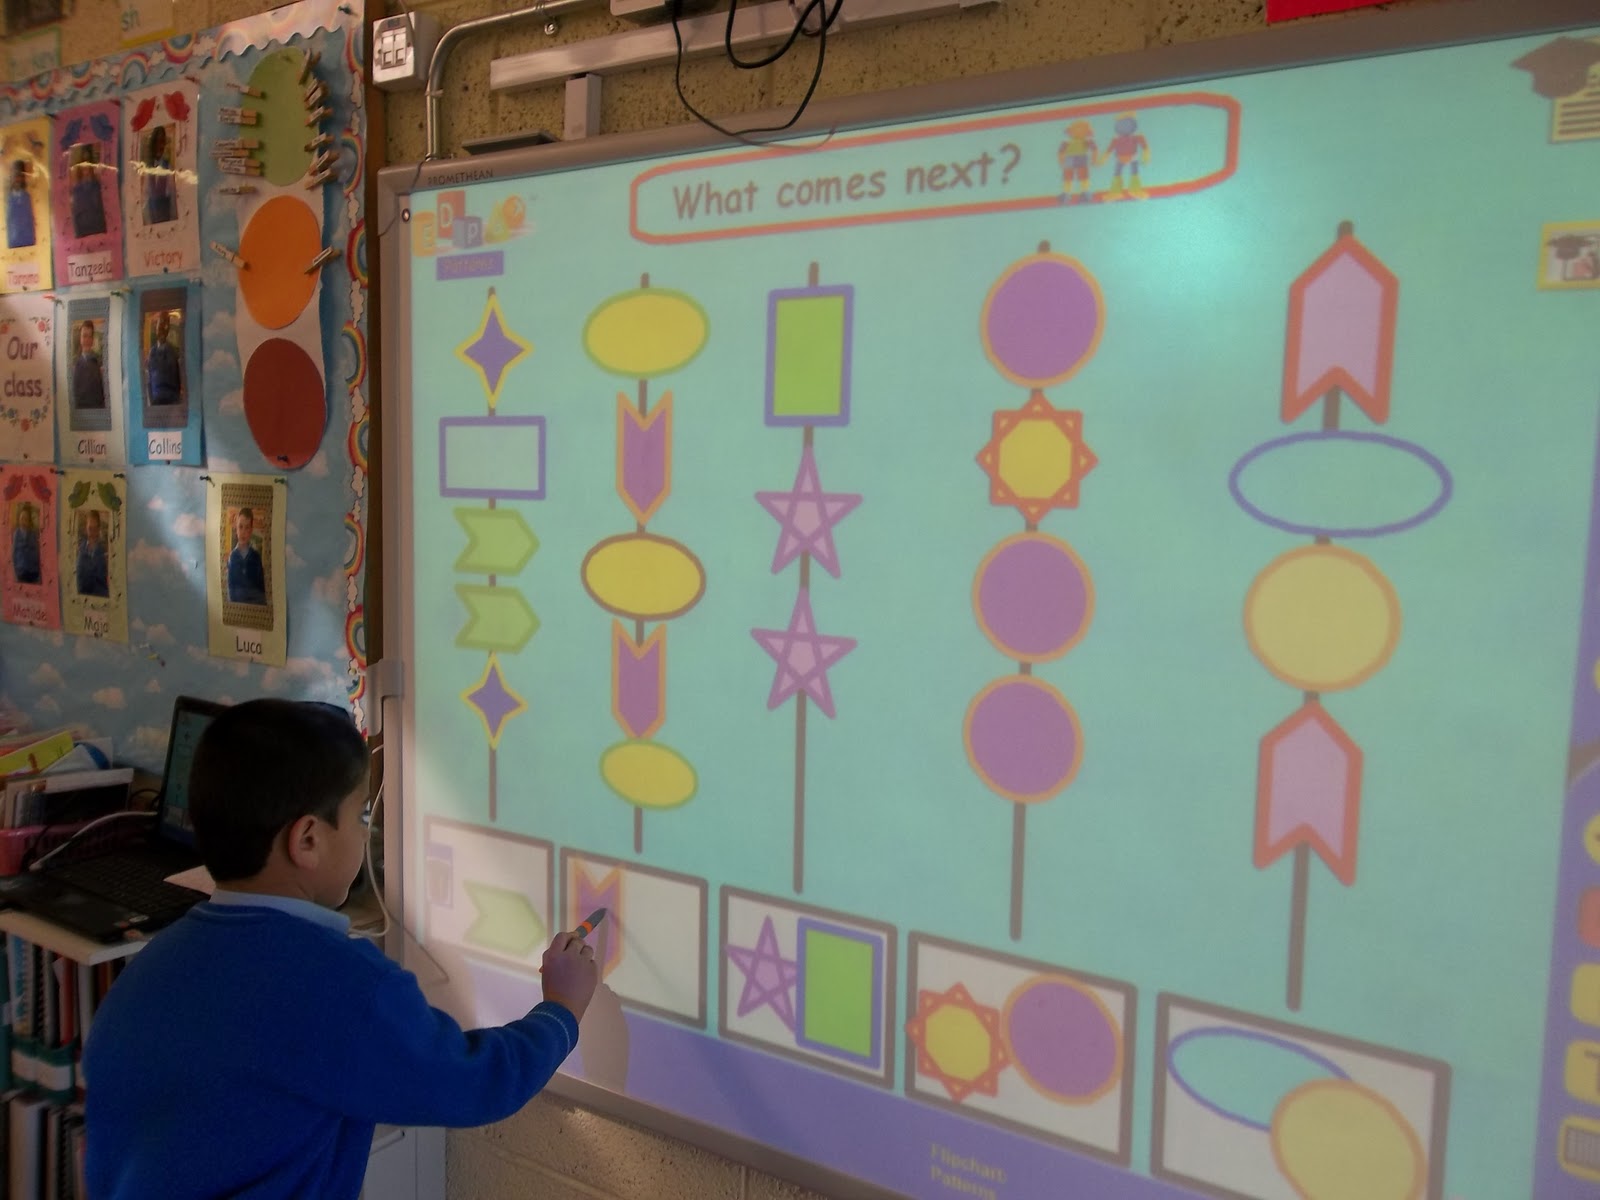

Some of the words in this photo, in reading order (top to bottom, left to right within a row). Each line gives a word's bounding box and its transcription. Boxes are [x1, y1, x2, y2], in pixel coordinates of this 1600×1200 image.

[427, 169, 494, 186] PROMETHEAN
[673, 181, 759, 220] What
[776, 171, 886, 208] comes
[905, 143, 1021, 195] next?
[68, 257, 112, 278] Tanzeela
[143, 250, 183, 269] Victory
[7, 336, 39, 360] Our
[4, 372, 43, 397] class
[77, 439, 107, 456] Cillian
[149, 439, 182, 456] Collins
[235, 635, 263, 655] Luca
